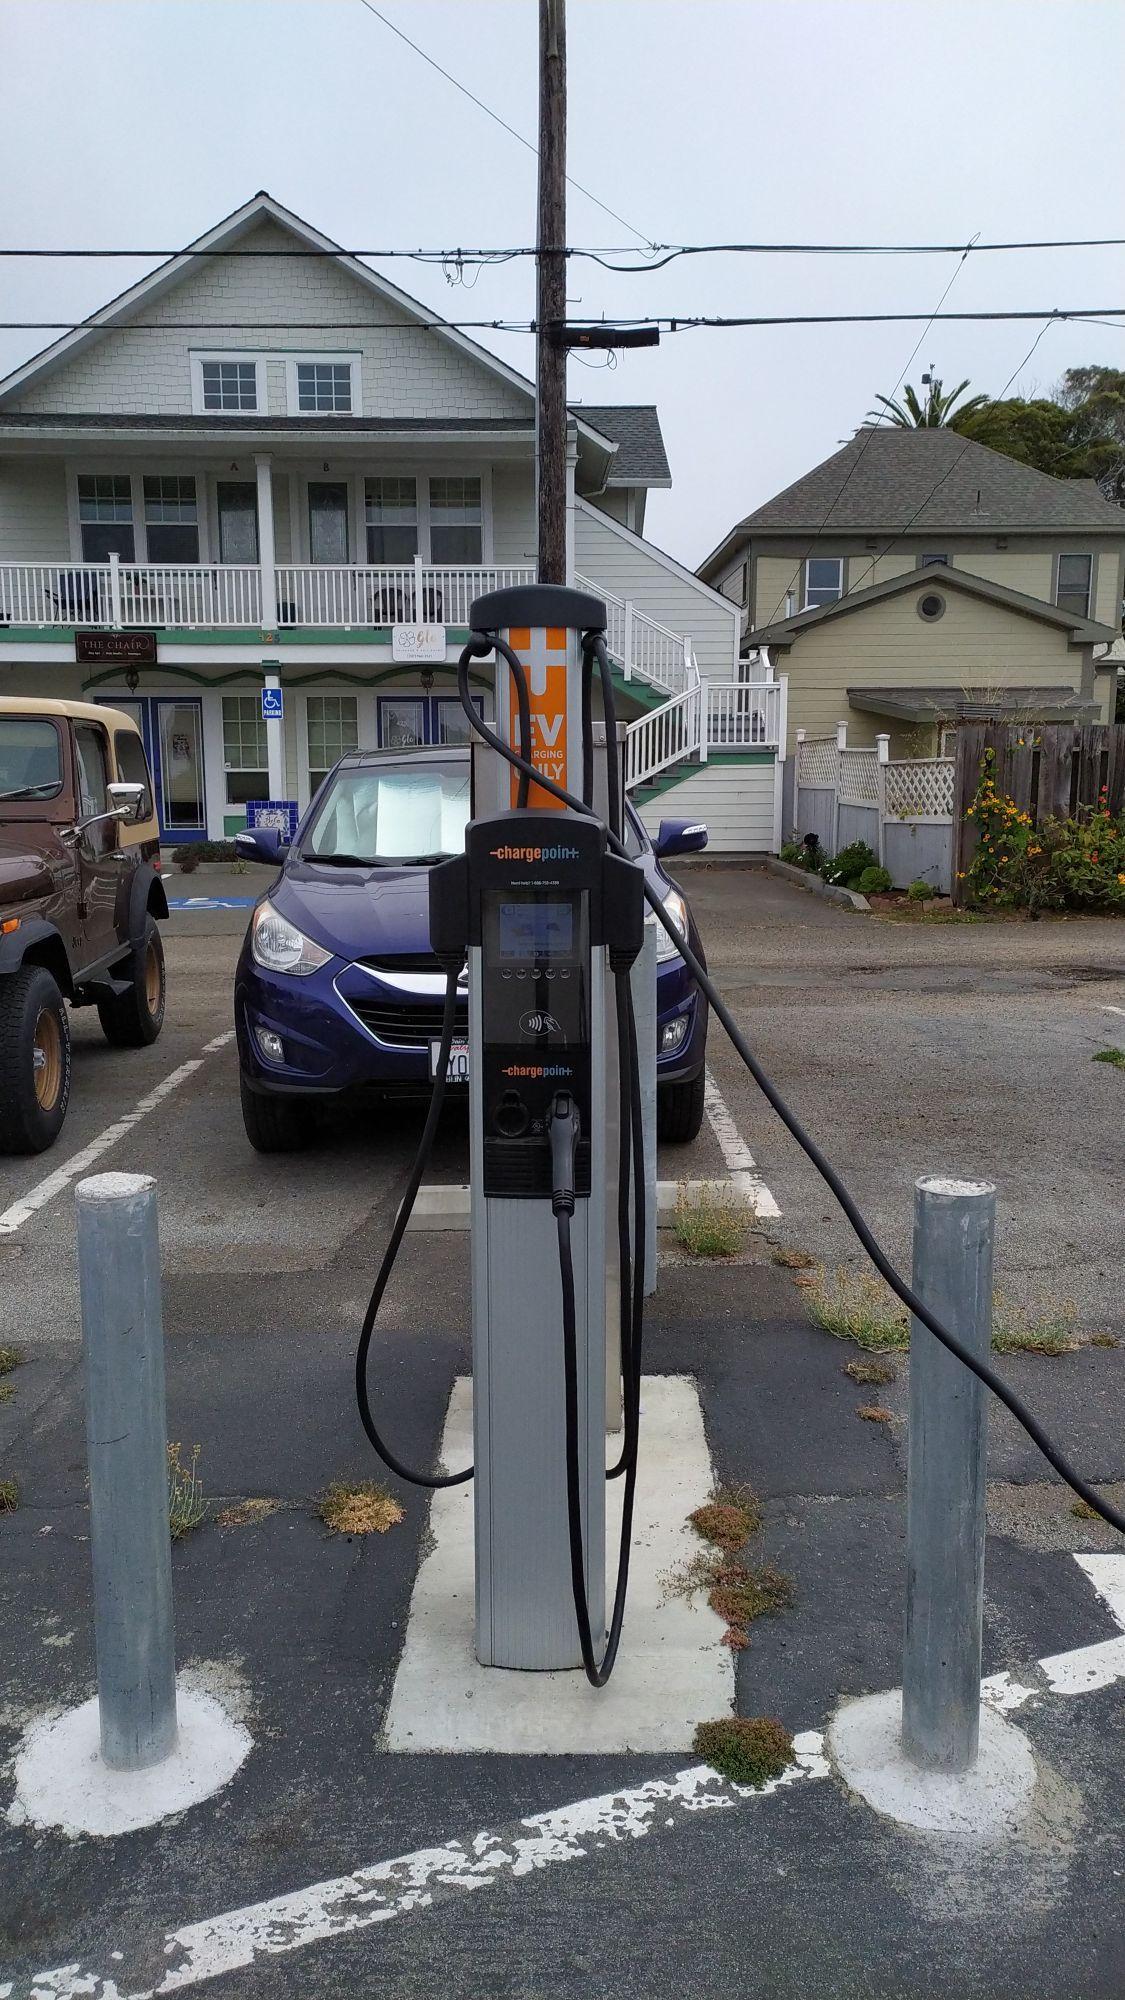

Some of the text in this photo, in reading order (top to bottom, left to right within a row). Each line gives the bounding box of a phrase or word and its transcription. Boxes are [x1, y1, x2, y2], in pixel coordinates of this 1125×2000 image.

[82, 638, 147, 650] THE CHAIR
[514, 714, 564, 747] EV
[514, 750, 564, 759] RGING
[514, 763, 564, 780] NLY
[448, 1054, 467, 1075] YO
